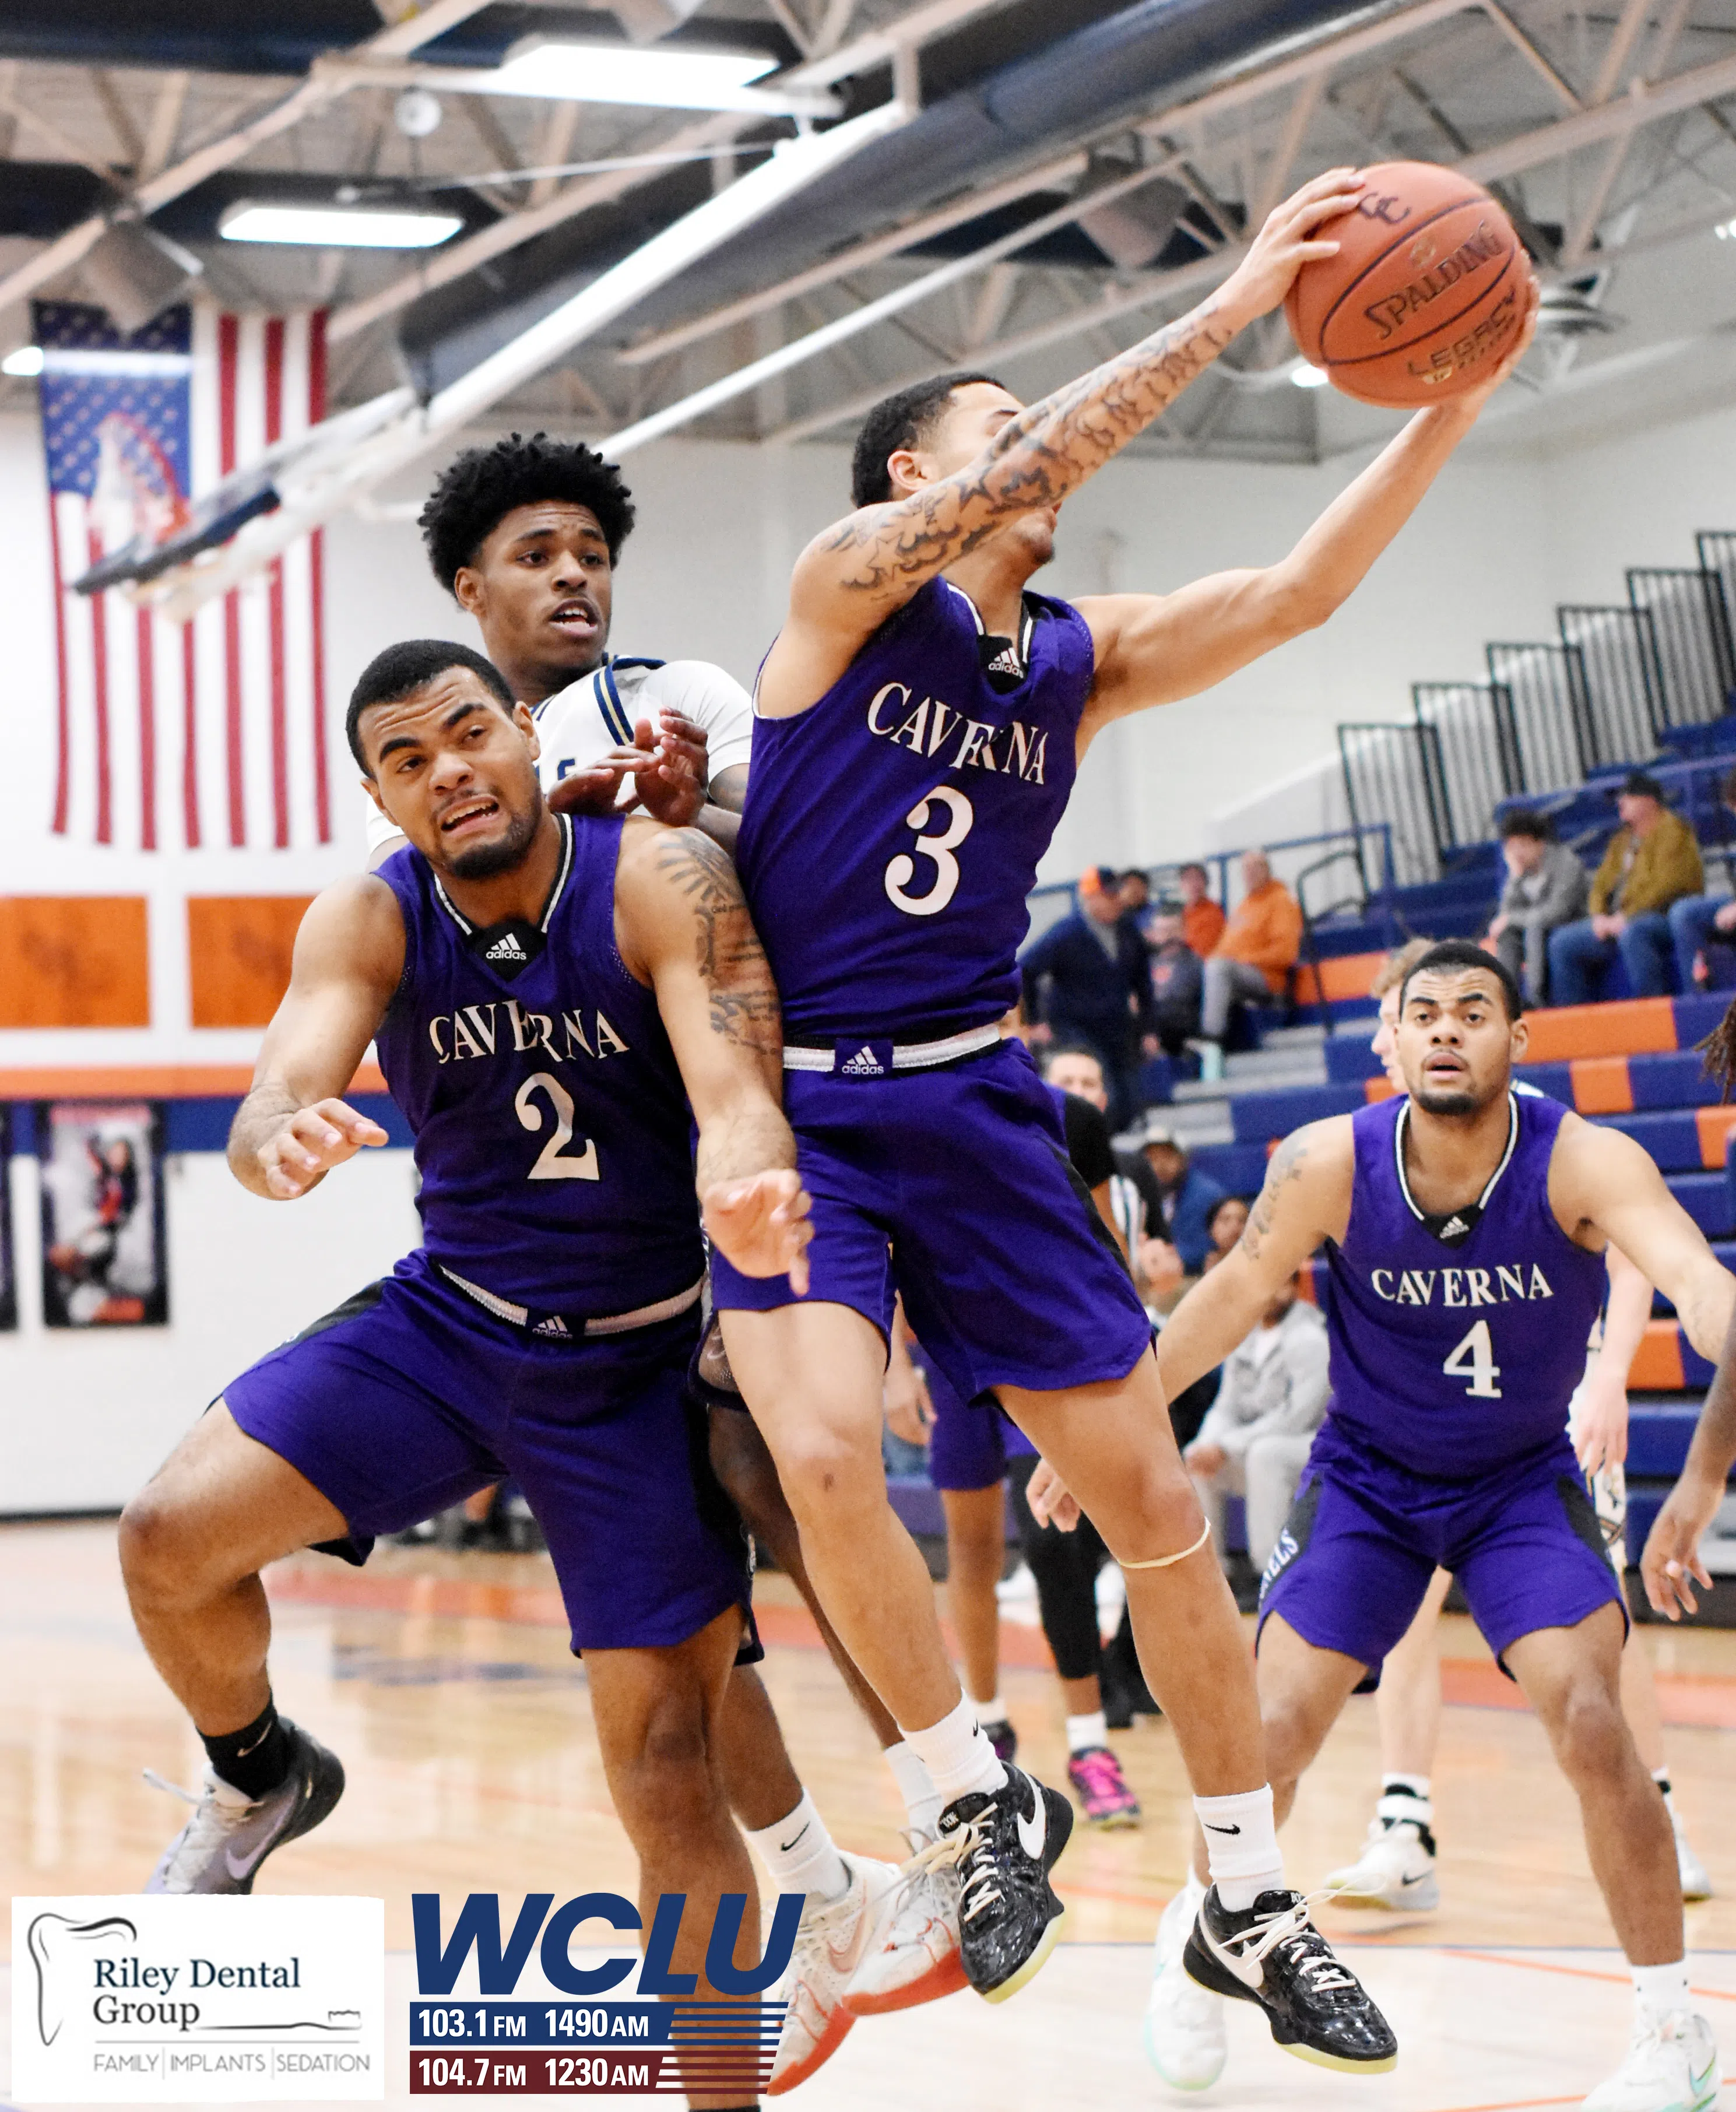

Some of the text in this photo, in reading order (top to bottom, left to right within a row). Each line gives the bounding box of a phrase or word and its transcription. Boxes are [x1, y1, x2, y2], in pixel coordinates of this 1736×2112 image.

[1363, 219, 1507, 340] SPALDING
[1407, 284, 1516, 377] LEGACY
[884, 786, 973, 915] 3
[486, 948, 527, 960] adidas
[429, 999, 630, 1064] CAVERNA
[841, 1064, 884, 1075] adidas
[515, 1073, 599, 1180] 2
[1371, 1263, 1554, 1307] CAVERNA
[1443, 1320, 1502, 1398] 4
